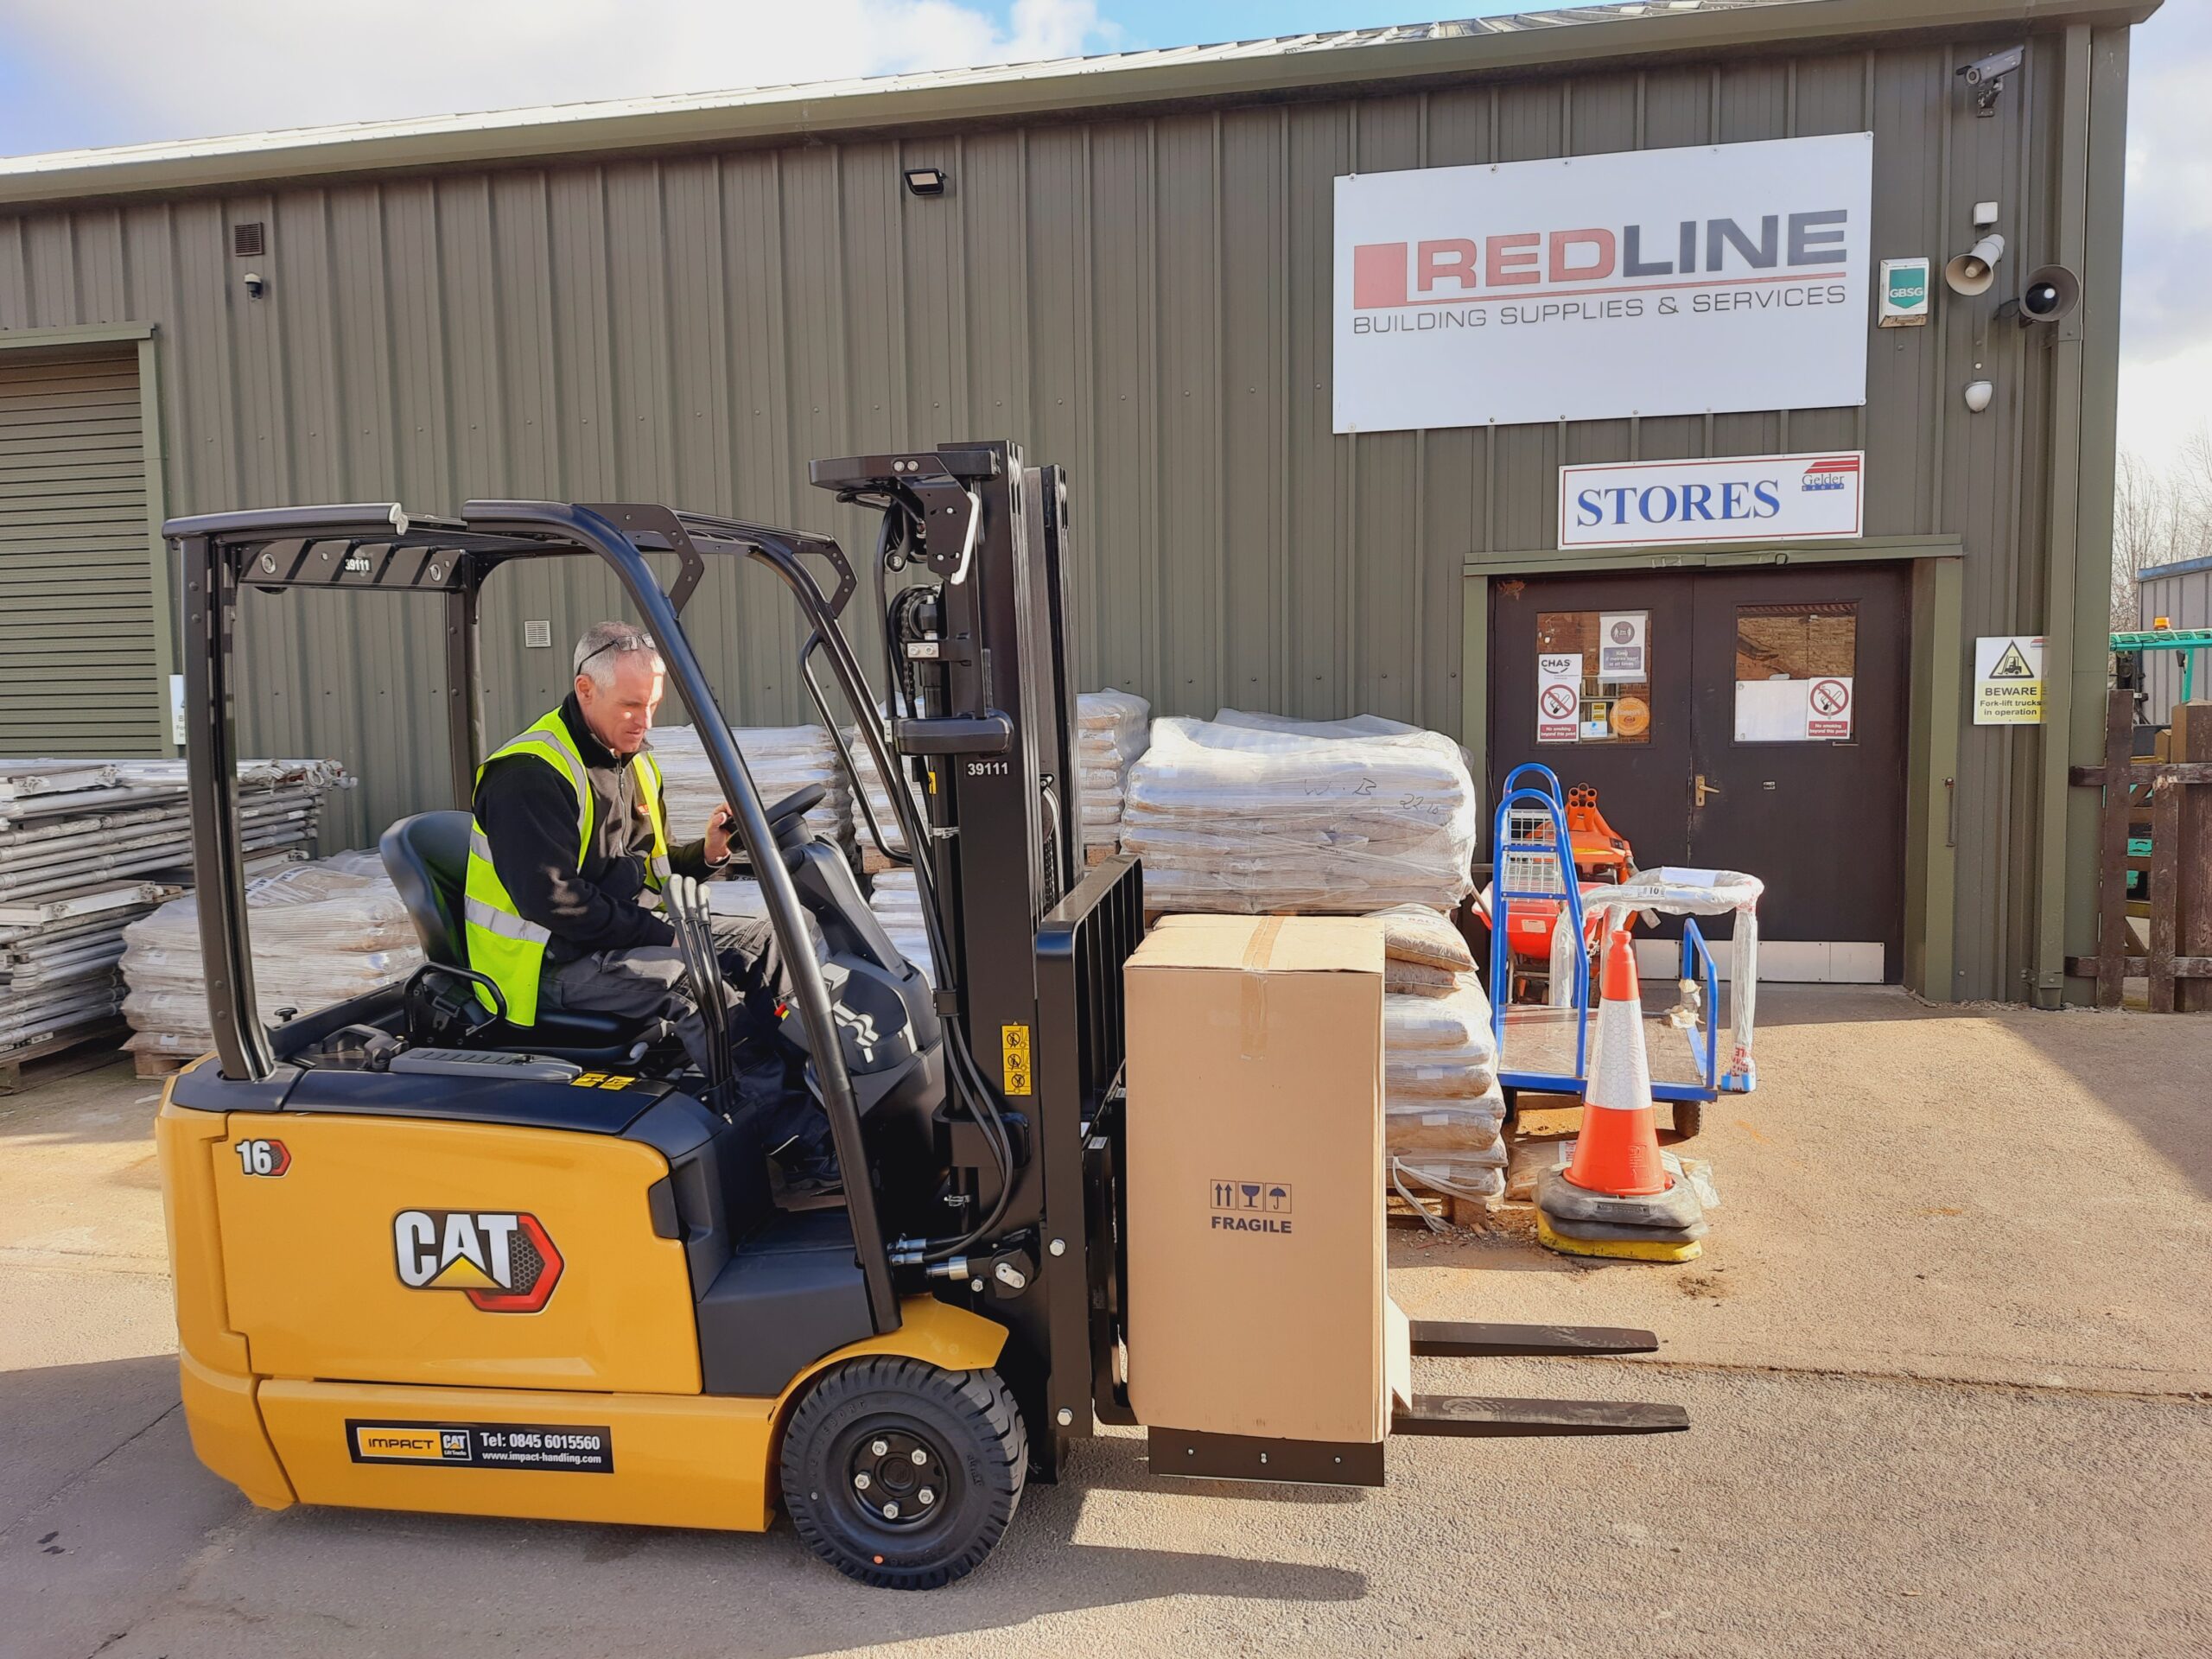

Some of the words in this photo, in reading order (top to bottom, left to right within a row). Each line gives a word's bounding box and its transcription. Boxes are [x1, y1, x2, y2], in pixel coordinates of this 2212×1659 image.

[1417, 209, 1847, 292] REDLINE
[1890, 287, 1923, 298] GBSG
[1353, 308, 1487, 334] BUILDING
[1500, 298, 1643, 325] SUPPLIES
[1657, 296, 1680, 315] &
[1693, 285, 1847, 313] SERVICES
[1802, 474, 1845, 486] Gelder
[1576, 479, 1781, 528] STORES
[345, 558, 370, 570] 39111
[1541, 658, 1571, 668] CHAS
[1985, 687, 2037, 696] BEWARE
[1994, 708, 2037, 717] operation
[967, 762, 1008, 776] 39111
[236, 1140, 272, 1175] 16
[1211, 1216, 1292, 1234] FRAGILE
[394, 1211, 518, 1288] CAT
[368, 1438, 434, 1450] IMPACT
[442, 1434, 467, 1449] CAT
[480, 1433, 506, 1447] Tel:
[509, 1433, 542, 1449] 0845
[544, 1434, 601, 1450] 6015560
[482, 1451, 602, 1465] www.impact-handling.com
